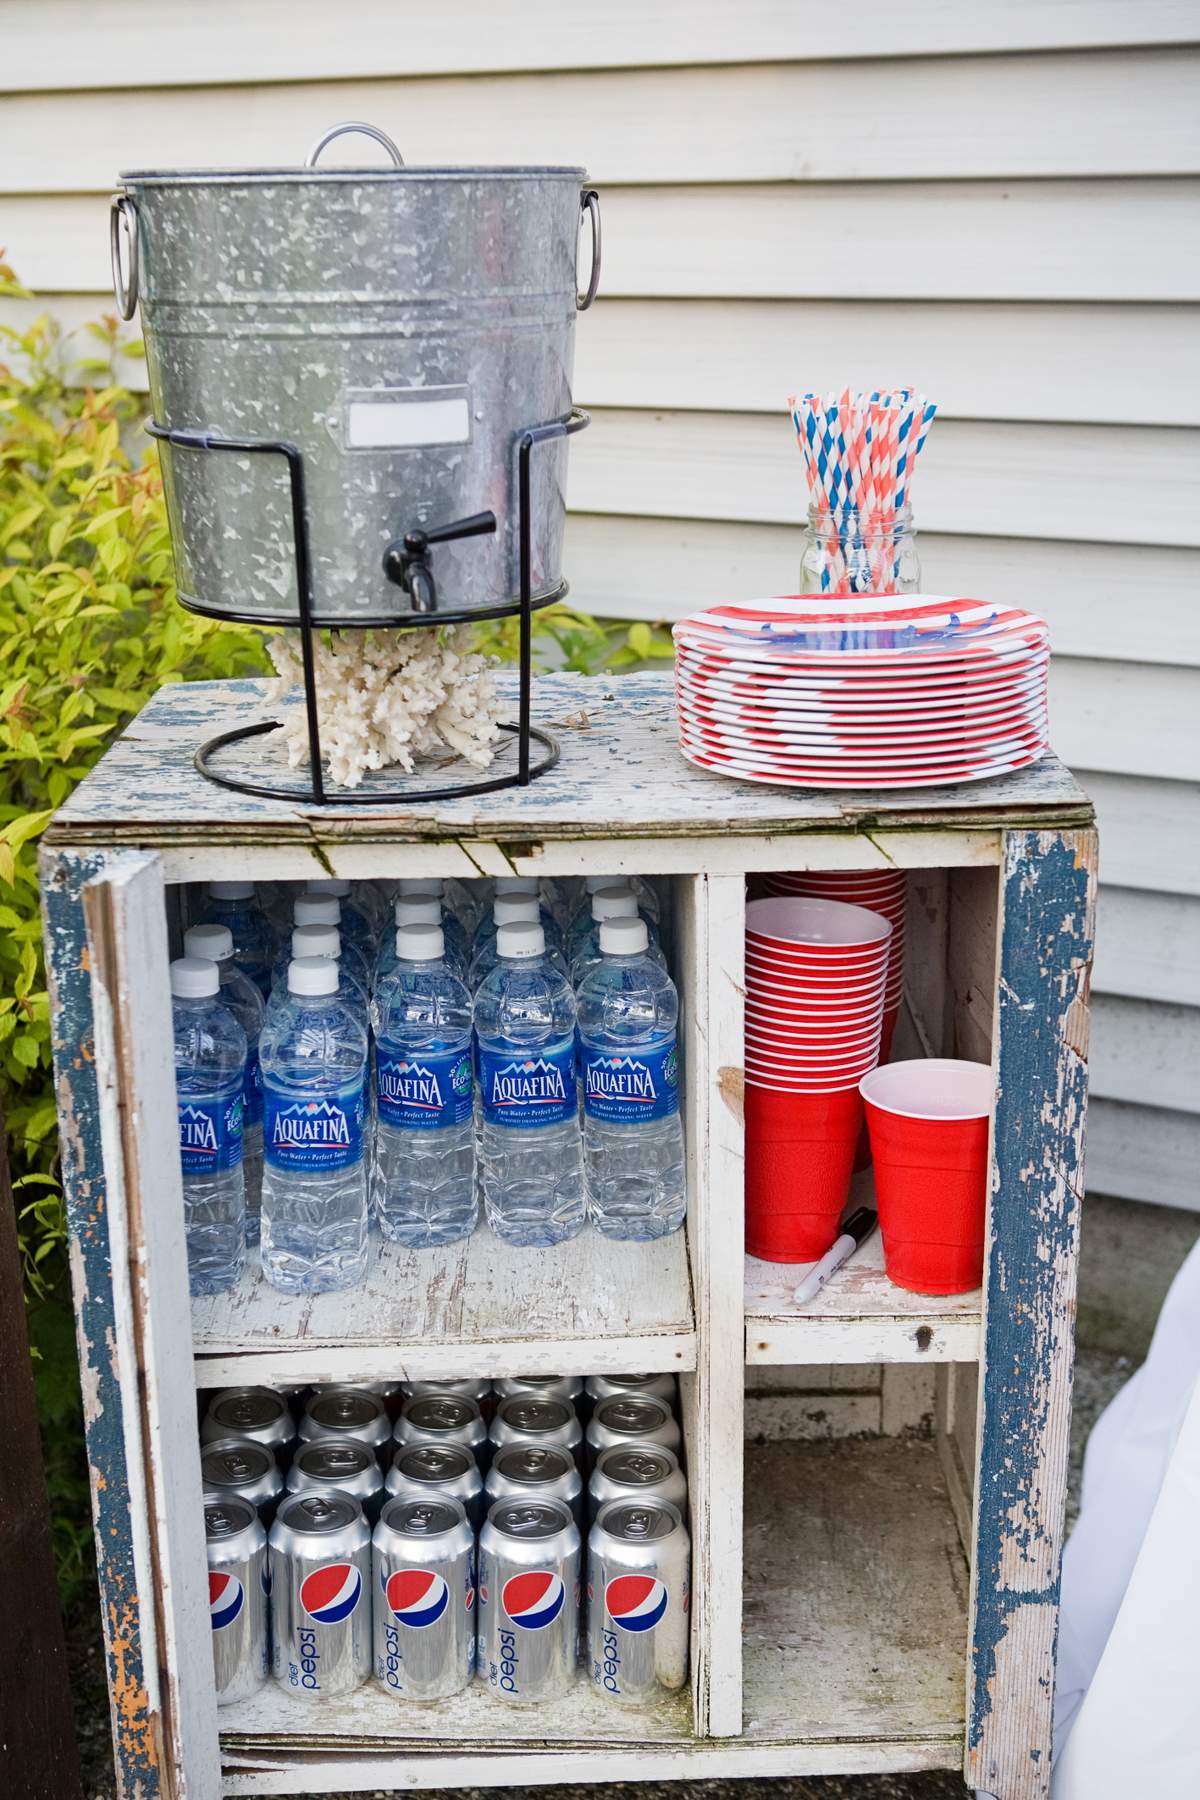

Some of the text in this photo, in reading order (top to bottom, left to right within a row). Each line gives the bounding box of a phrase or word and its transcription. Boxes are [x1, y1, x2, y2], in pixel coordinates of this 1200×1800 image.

[491, 1067, 566, 1105] AQUAFINA
[586, 1064, 657, 1100] AQUAFINA
[404, 1111, 423, 1119] Perfect
[531, 1107, 551, 1116] Perfect
[618, 1105, 638, 1113] Perfect
[179, 1117, 218, 1150] FINA
[272, 1111, 351, 1148] AQUAFINA
[312, 1153, 332, 1161] Perfect
[297, 1626, 321, 1690] pepsi
[383, 1622, 403, 1690] pepsi
[497, 1628, 519, 1693] pepsi
[601, 1627, 621, 1694] pepsi
[289, 1661, 299, 1687] diet
[488, 1661, 498, 1687] diet
